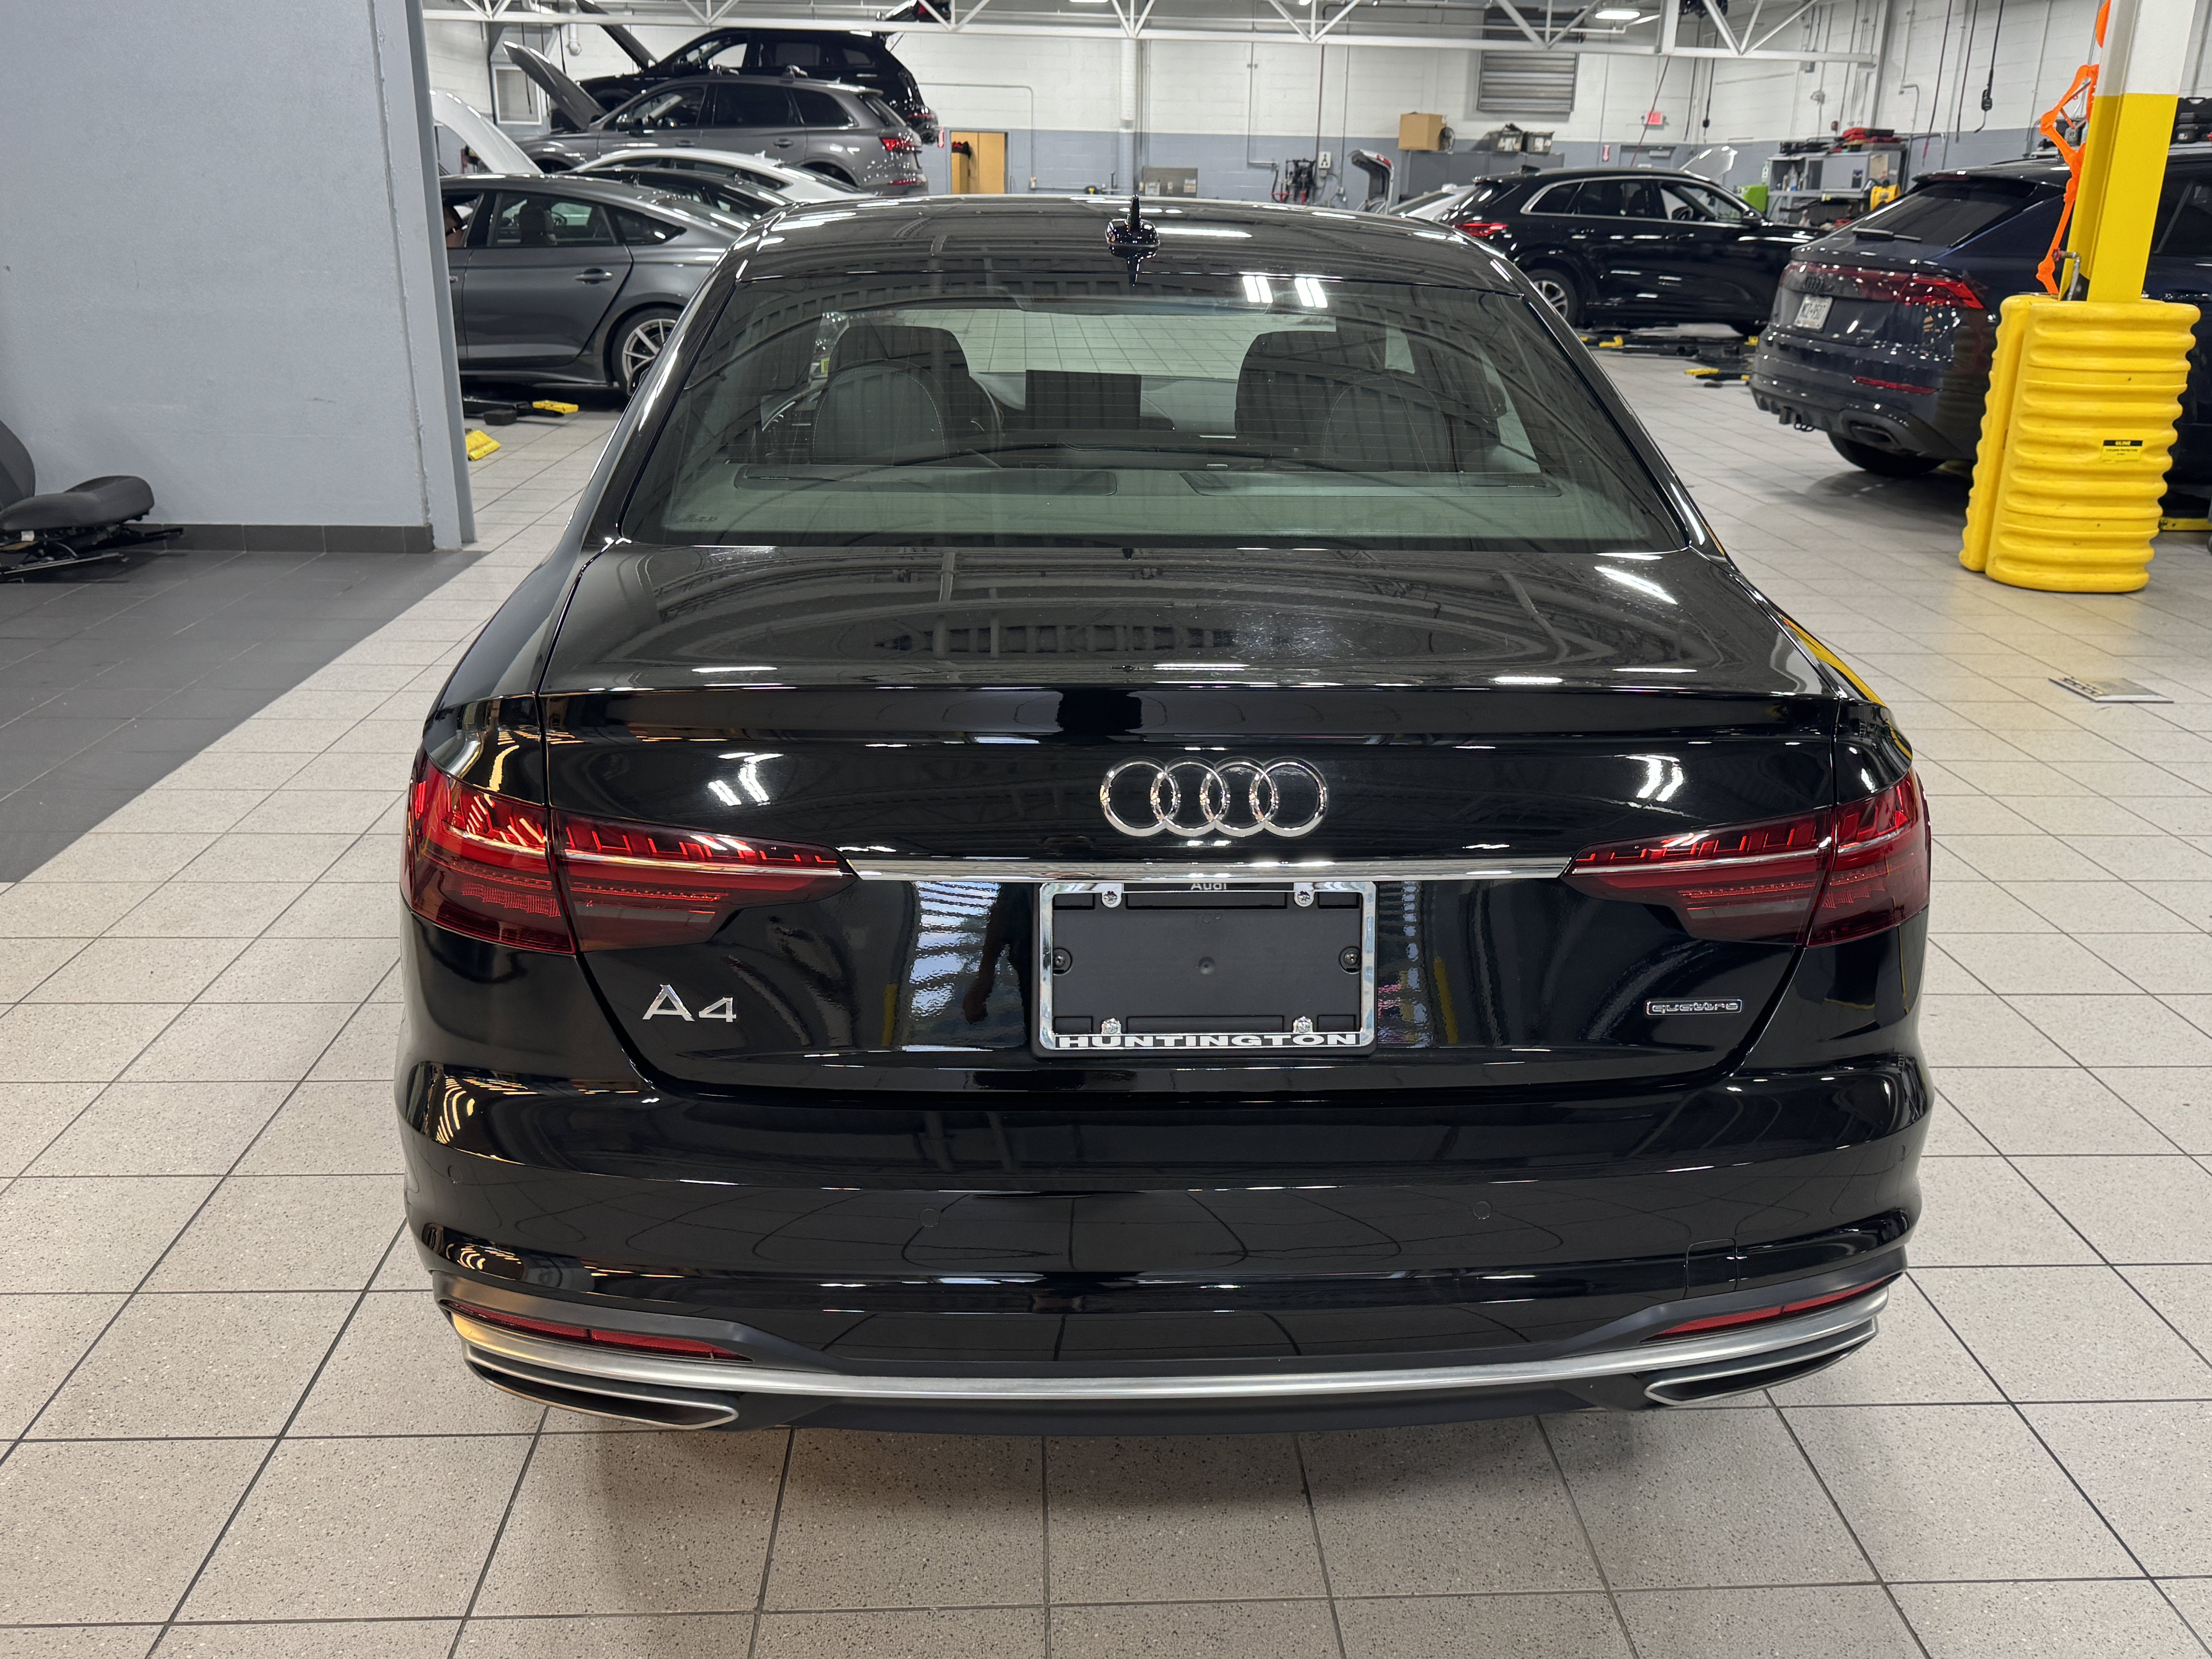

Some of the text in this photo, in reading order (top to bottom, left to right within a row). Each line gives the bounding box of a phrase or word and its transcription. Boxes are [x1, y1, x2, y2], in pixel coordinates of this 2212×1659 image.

[642, 984, 737, 1022] A4
[1652, 1002, 1738, 1014] quattro
[1059, 1034, 1356, 1047] HUNTINGTON
